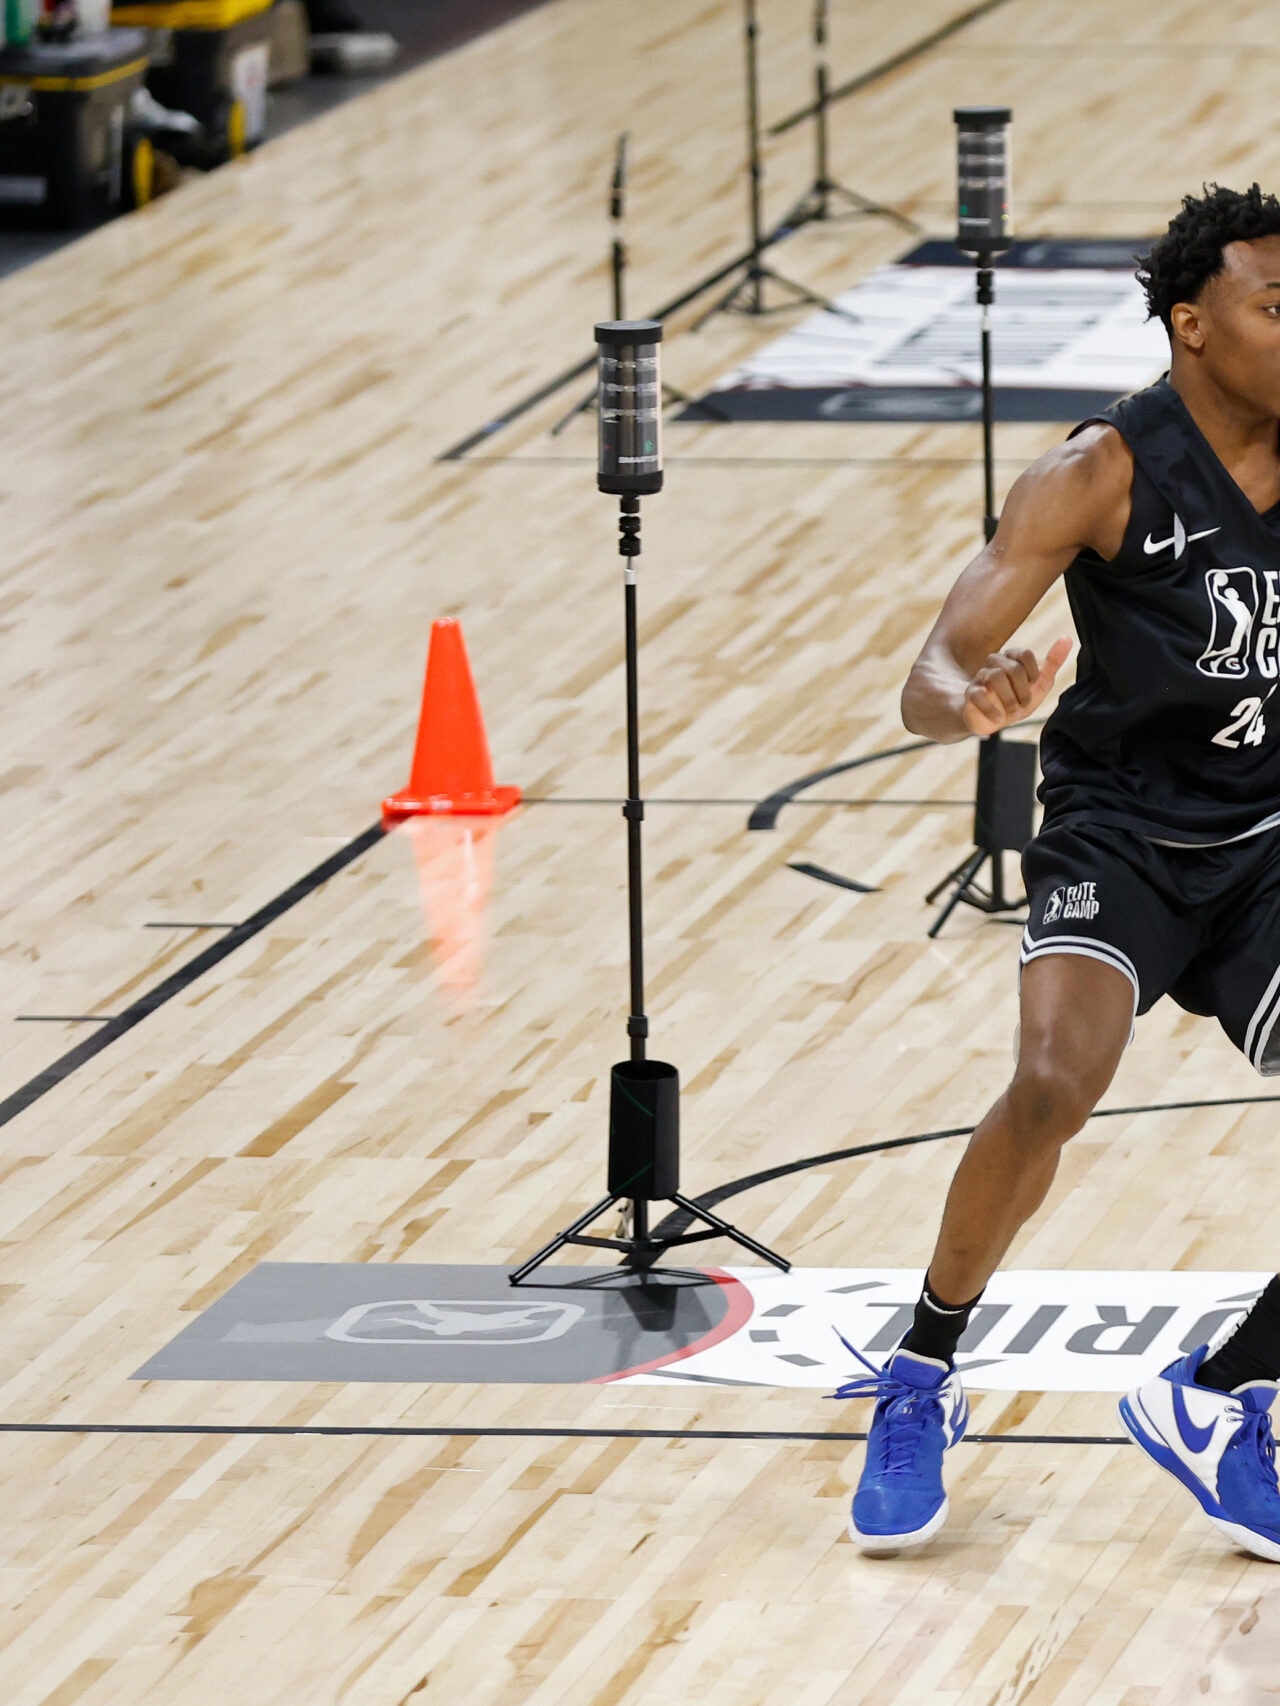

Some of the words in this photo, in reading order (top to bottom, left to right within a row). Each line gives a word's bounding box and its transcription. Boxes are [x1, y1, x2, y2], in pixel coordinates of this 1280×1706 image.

[1211, 683, 1278, 748] 24
[1066, 882, 1097, 902] ELITE
[1063, 901, 1100, 919] CAMP
